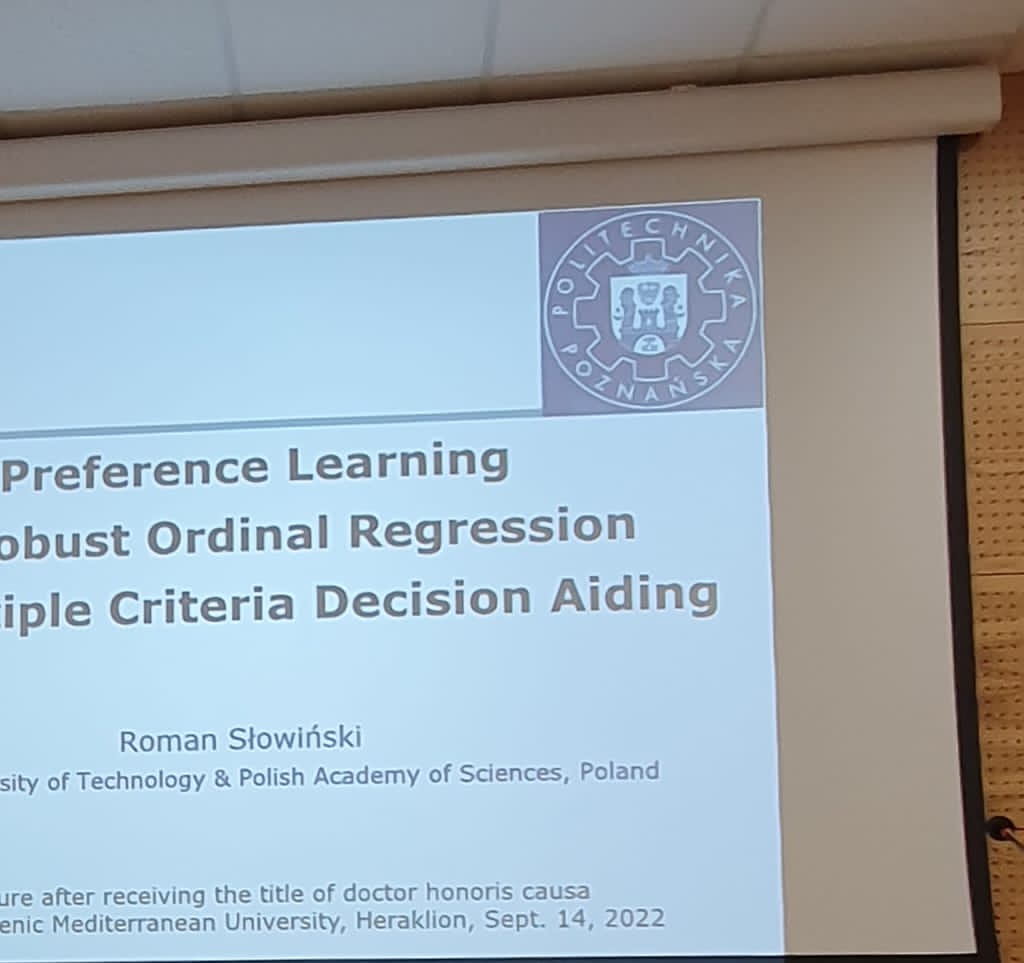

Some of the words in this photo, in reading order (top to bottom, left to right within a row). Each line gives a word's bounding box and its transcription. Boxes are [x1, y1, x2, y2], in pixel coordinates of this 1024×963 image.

[552, 219, 746, 315] POLITECHNIKA
[2, 455, 268, 492] Preference
[289, 441, 508, 482] Learning
[148, 515, 327, 555] Ordinal
[351, 506, 634, 554] Regression
[110, 586, 293, 625] Criteria
[316, 579, 530, 618] Decision
[550, 574, 717, 618] Aiding
[121, 731, 216, 752] Roman
[229, 724, 361, 750] Słowiński
[48, 772, 70, 791] of
[76, 770, 206, 792] Technology
[215, 769, 231, 787] &
[240, 767, 304, 786] Polish
[314, 765, 420, 787] Academy
[429, 763, 452, 783] of
[460, 764, 569, 784] Sciences,
[581, 760, 659, 781] Poland
[42, 887, 96, 906] after
[104, 887, 205, 908] receiving
[215, 885, 251, 904] the
[261, 884, 304, 903] title
[313, 883, 336, 903] of
[343, 883, 418, 902] doctor
[427, 882, 513, 901] honoris
[523, 885, 590, 900] causa
[53, 914, 215, 933] Mediterranean
[226, 912, 346, 934] University,
[357, 910, 474, 933] Heraklion,
[485, 910, 545, 932] Sept.
[558, 909, 594, 931] 14,
[605, 908, 664, 928] 2022
